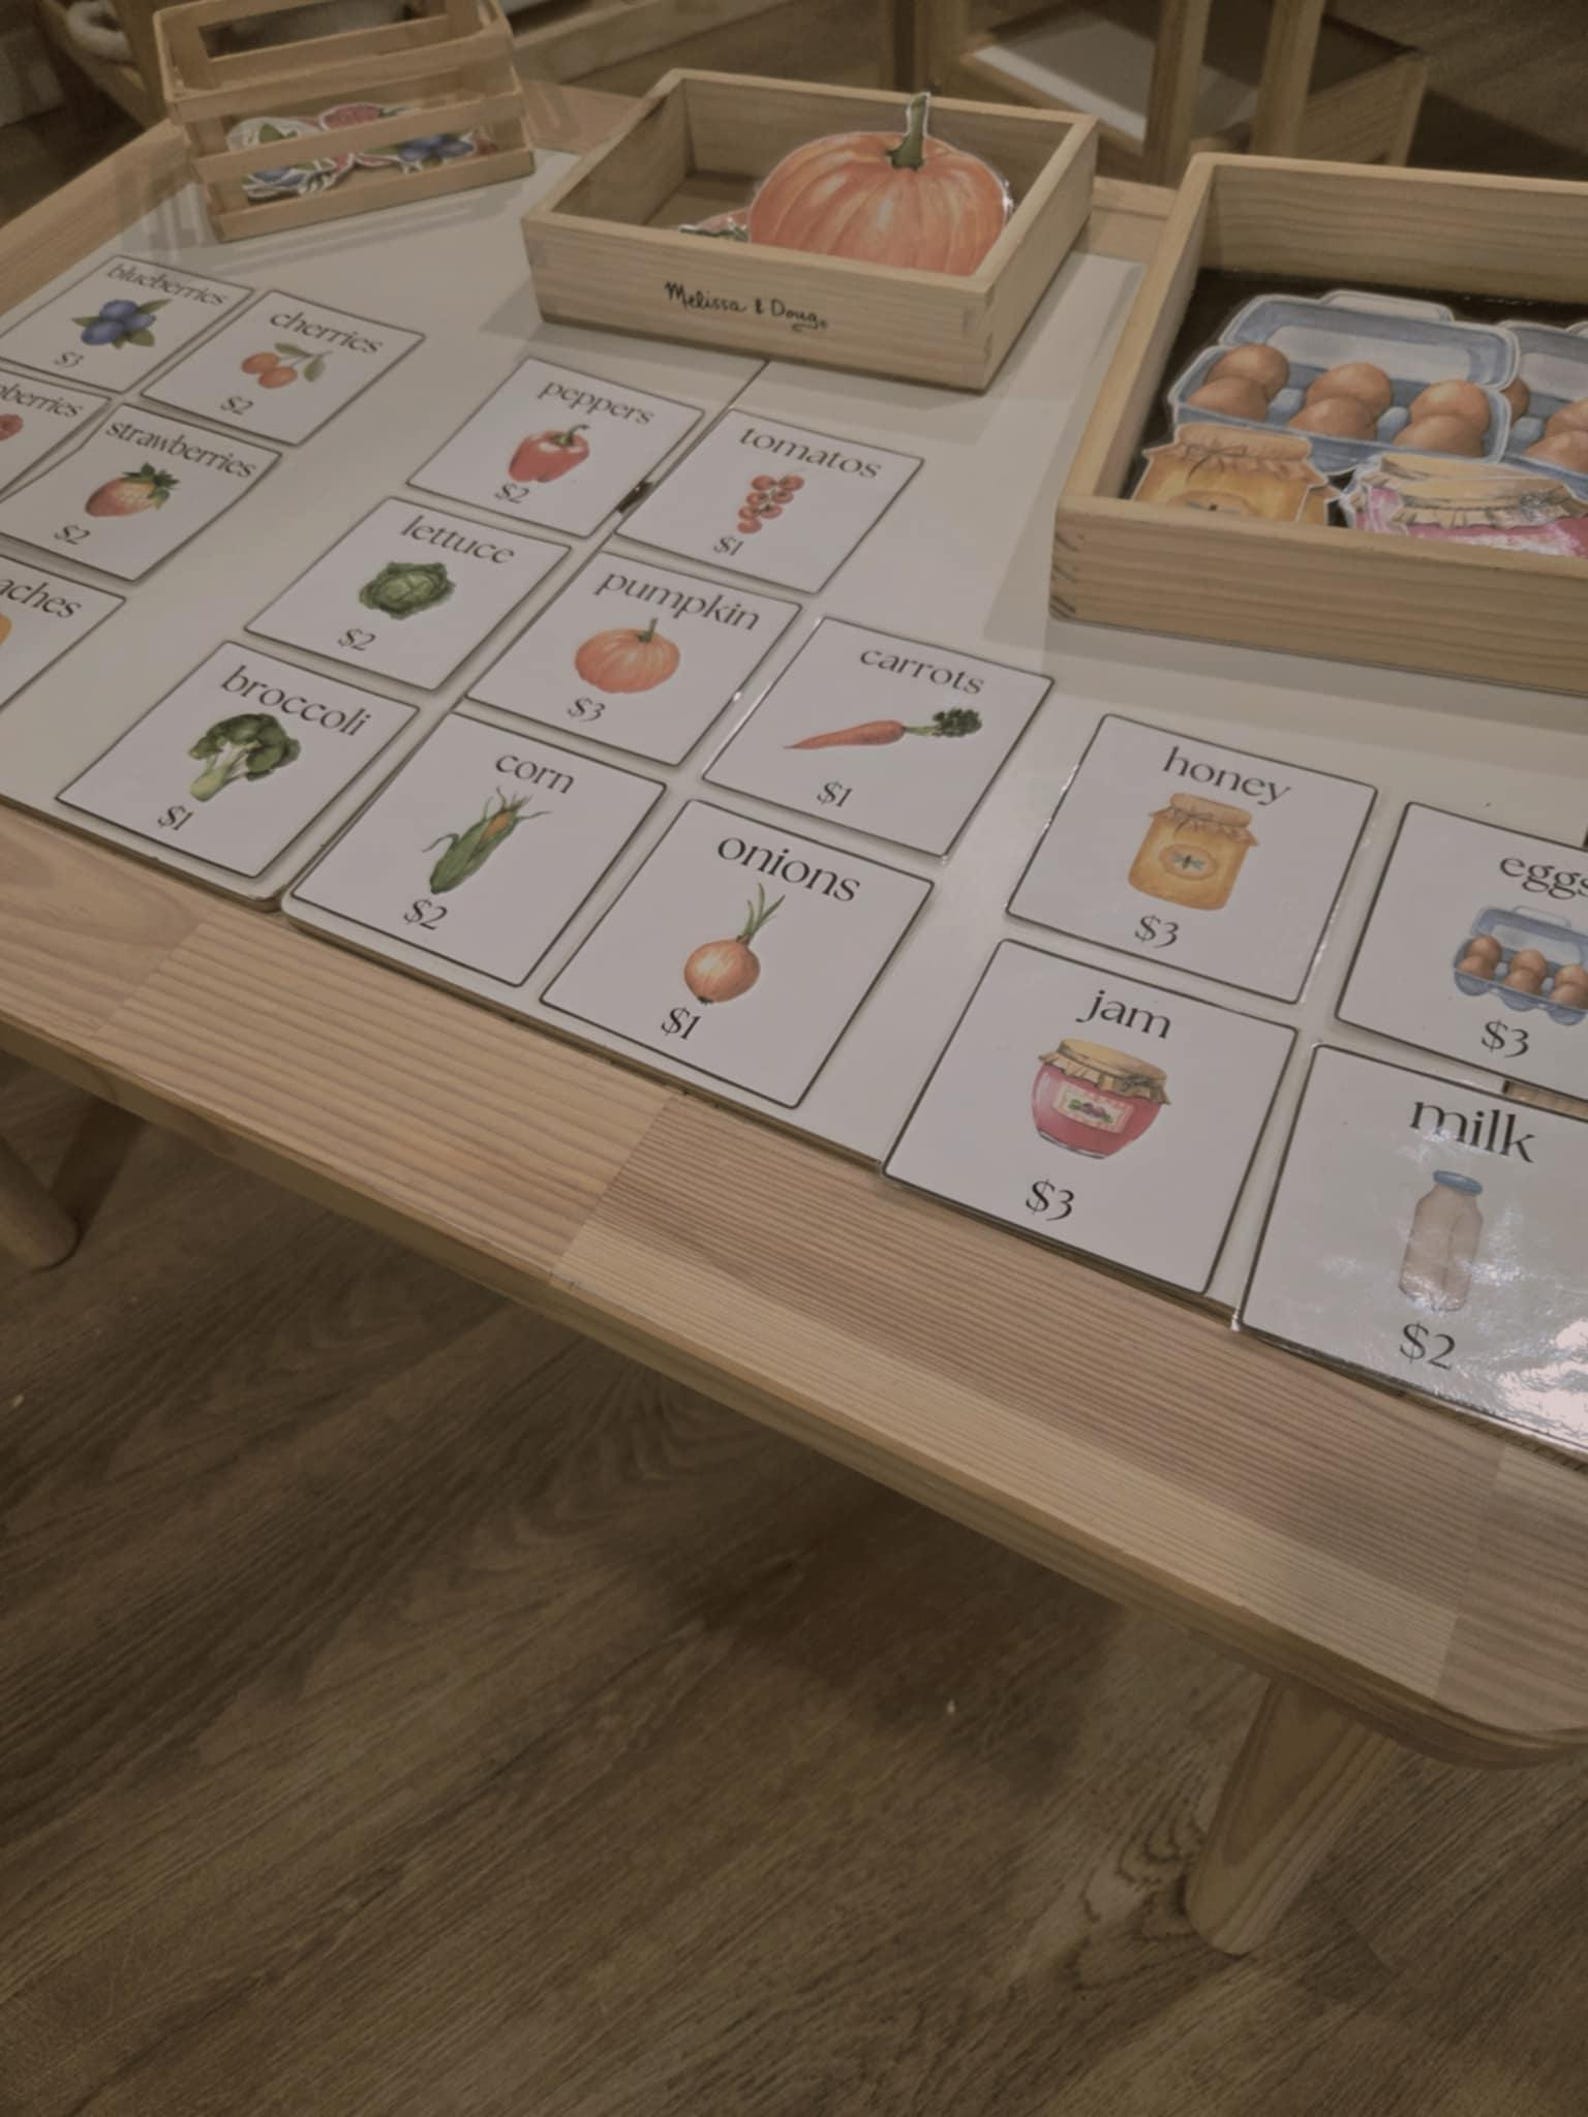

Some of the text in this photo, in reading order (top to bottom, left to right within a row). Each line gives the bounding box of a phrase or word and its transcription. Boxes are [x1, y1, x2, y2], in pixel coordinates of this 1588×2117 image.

[107, 264, 228, 306] blueberries
[664, 280, 747, 312] Melissa
[270, 308, 384, 356] cherries
[220, 396, 253, 416] $2
[537, 379, 655, 426] peppers
[106, 420, 256, 480] strawberries
[740, 427, 883, 480] tomatos
[494, 482, 531, 505] $2
[53, 523, 92, 546] $2
[400, 515, 516, 565] lettuce
[713, 535, 744, 558] $1
[596, 570, 761, 631] pumpkin
[337, 627, 377, 652] $2
[860, 649, 985, 696] carrots
[220, 665, 371, 737] broccoli
[568, 697, 608, 722] $3
[495, 753, 575, 795] corn
[816, 781, 854, 808] $1
[1162, 747, 1292, 806] honey
[157, 804, 196, 832] $1
[717, 837, 861, 903] onions
[403, 899, 448, 931] $2
[1134, 914, 1180, 948] $3
[661, 1007, 702, 1041] $1
[1076, 990, 1171, 1039] jam
[1480, 1019, 1530, 1059] $3
[1409, 1100, 1536, 1164] milk
[1024, 1178, 1075, 1222] $3
[1400, 1321, 1456, 1370] $2
